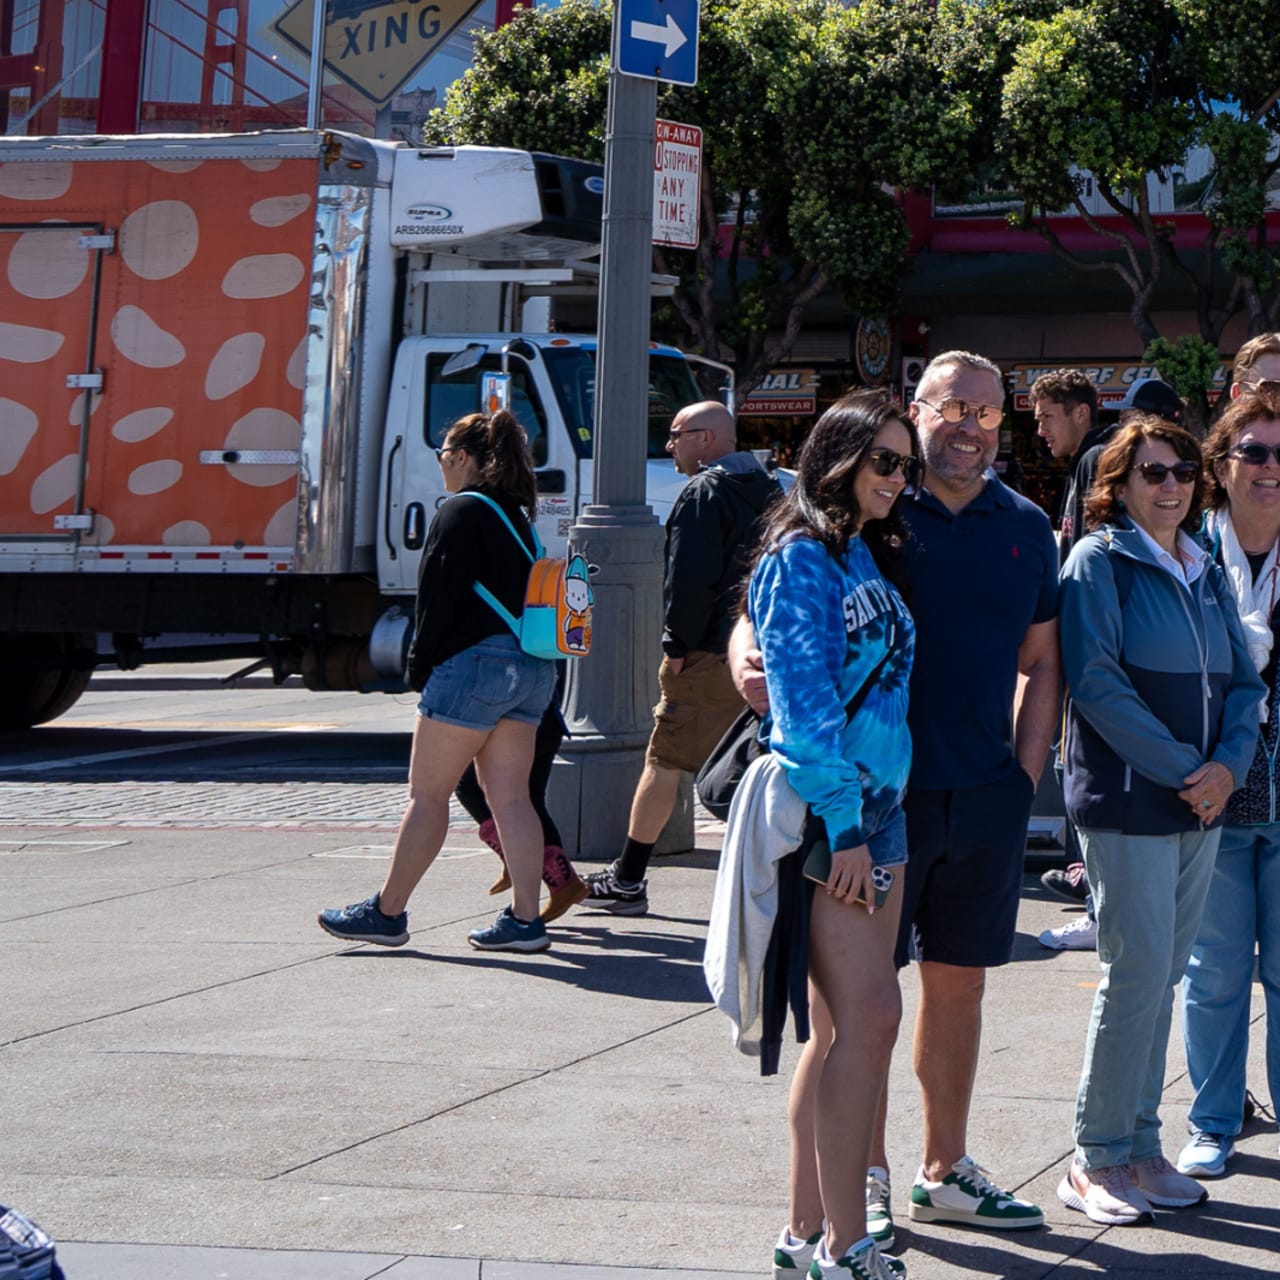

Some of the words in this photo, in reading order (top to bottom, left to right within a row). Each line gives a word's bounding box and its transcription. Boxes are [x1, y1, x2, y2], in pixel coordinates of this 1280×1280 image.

[340, 5, 441, 60] XING
[656, 123, 699, 144] OW-AWAY
[663, 149, 698, 174] STOPPING
[661, 176, 685, 197] ANY
[407, 208, 442, 217] SUPRA
[659, 200, 686, 223] TIME
[740, 402, 811, 411] PORTSWEAR
